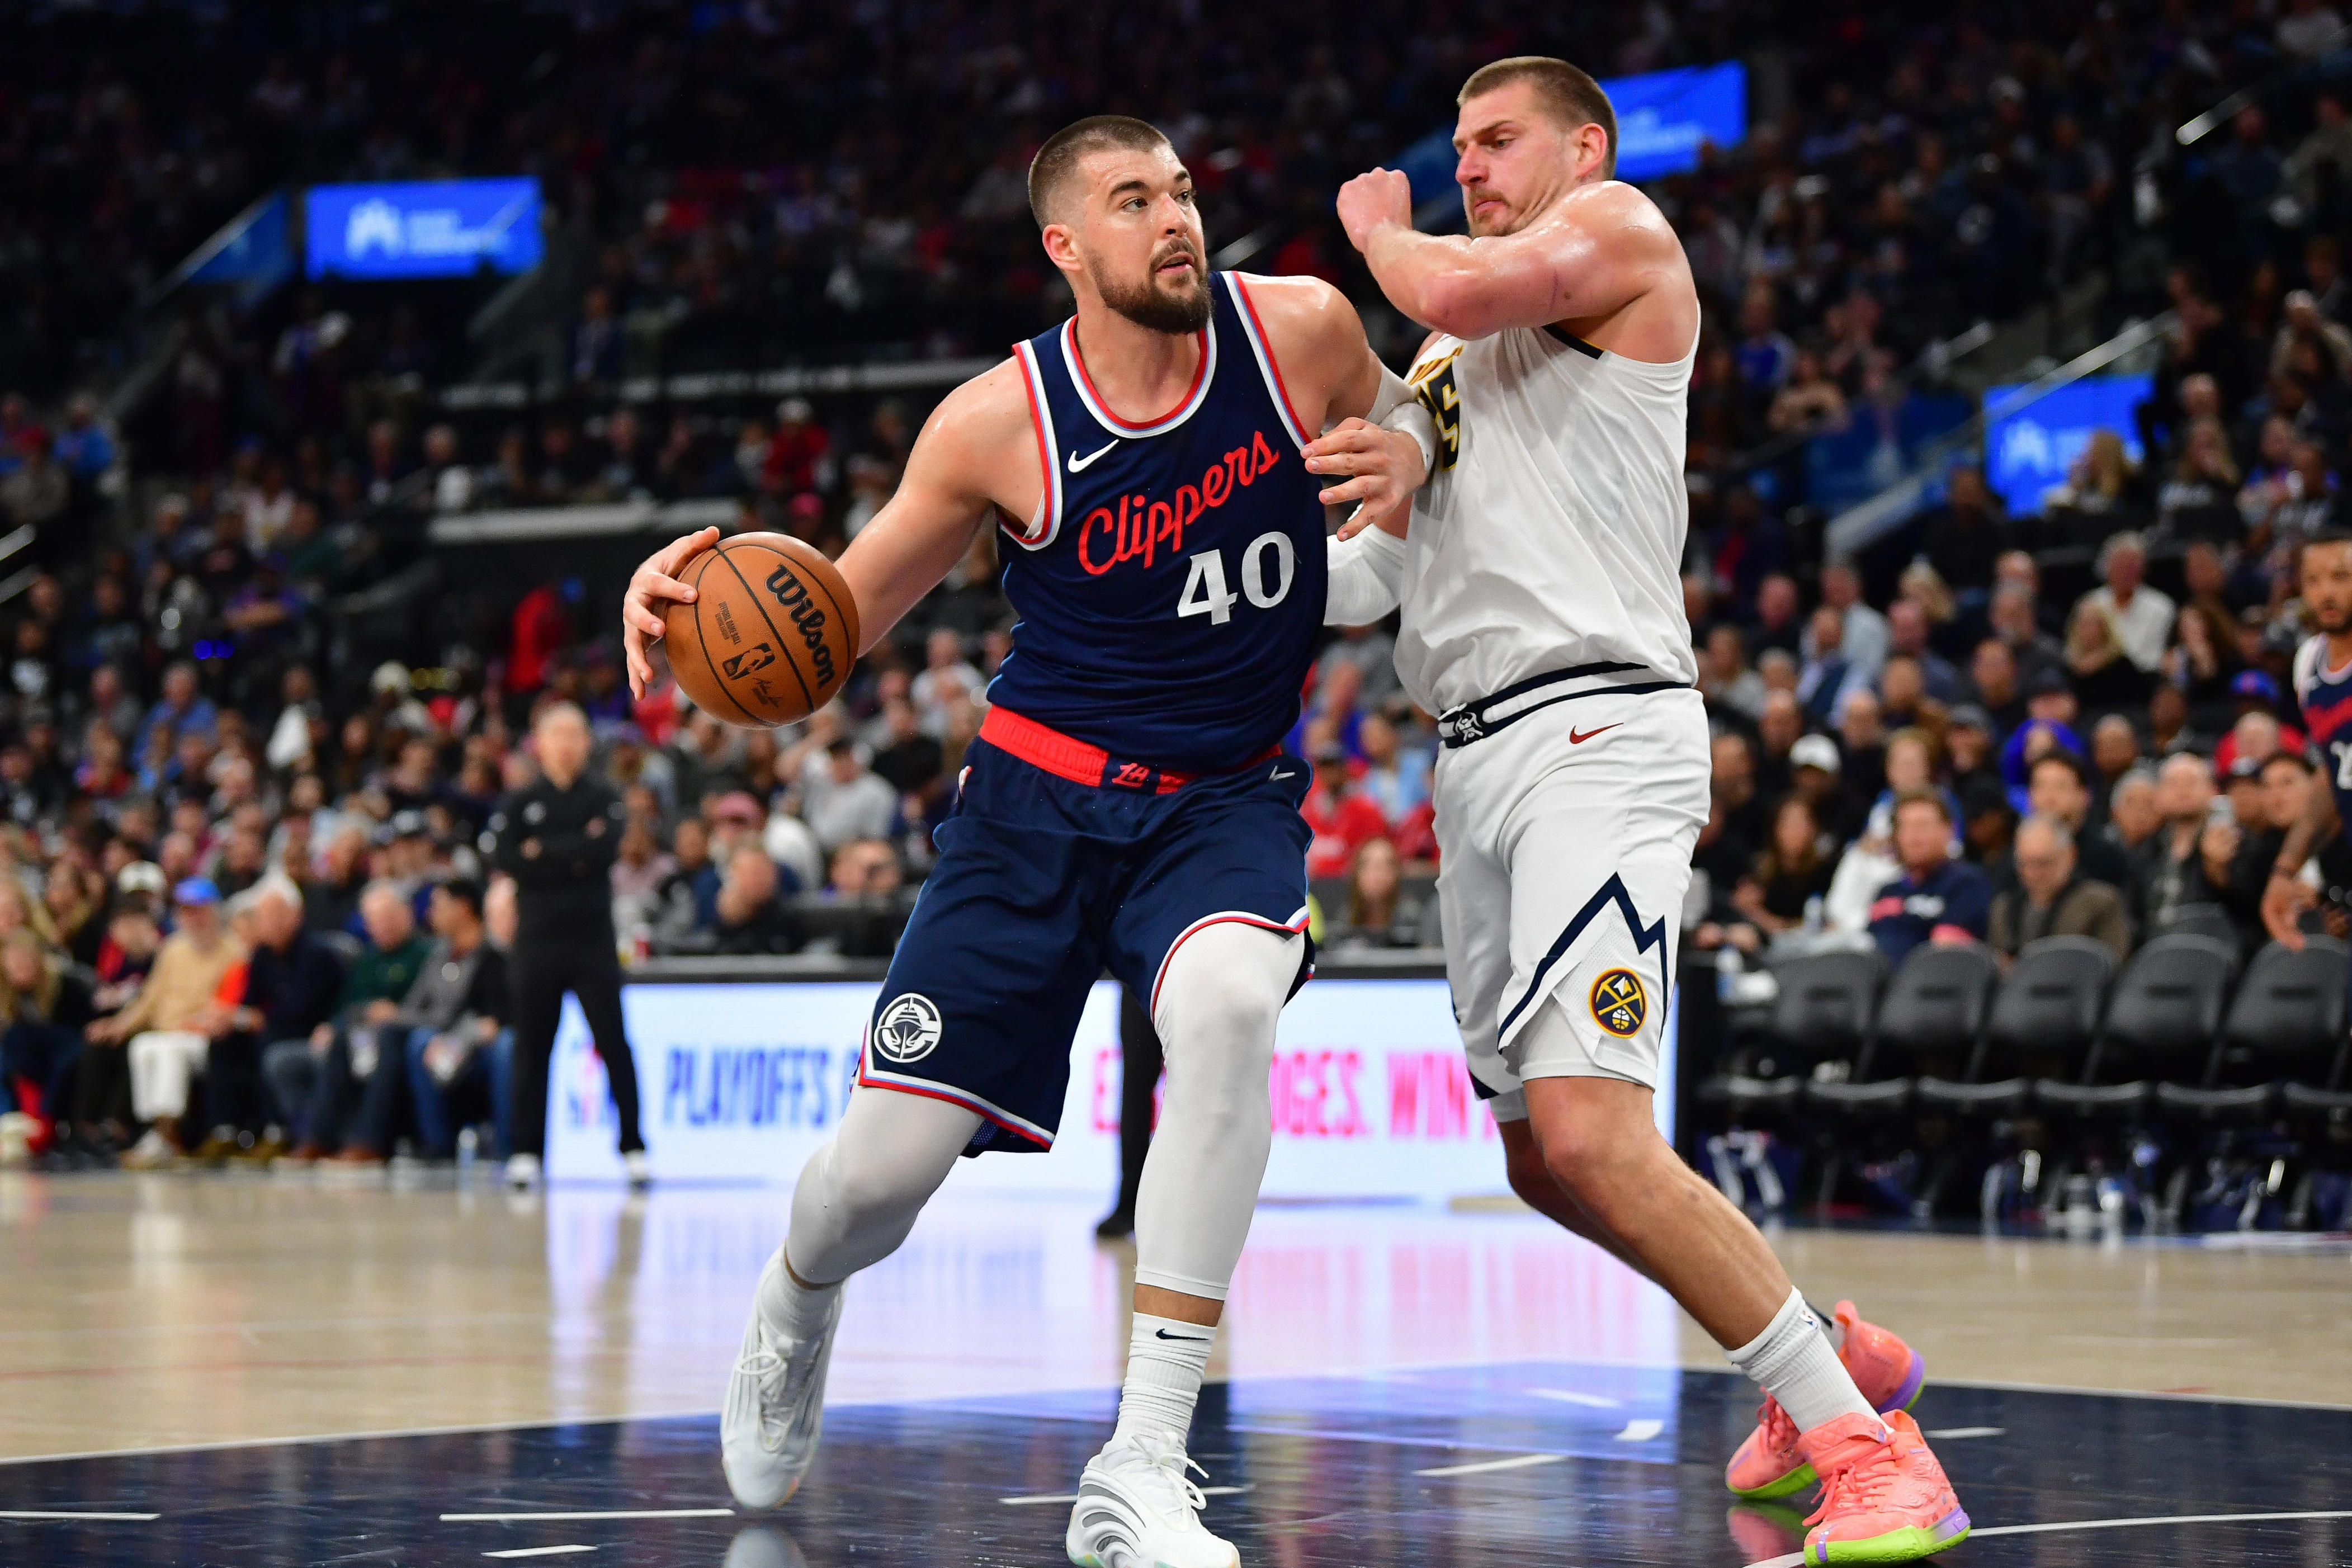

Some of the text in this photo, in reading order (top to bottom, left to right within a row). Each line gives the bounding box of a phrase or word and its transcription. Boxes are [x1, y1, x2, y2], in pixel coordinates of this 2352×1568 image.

[1078, 431, 1280, 575] Clippers
[1177, 531, 1295, 625] 40
[719, 601, 731, 622] OFFICIAL
[726, 620, 737, 635] GAME
[731, 632, 741, 645] BALL
[765, 563, 835, 689] Wilson
[1112, 763, 1150, 788] LA
[665, 1046, 829, 1126] PLAYOFFS
[1386, 1051, 1471, 1139] WIN
